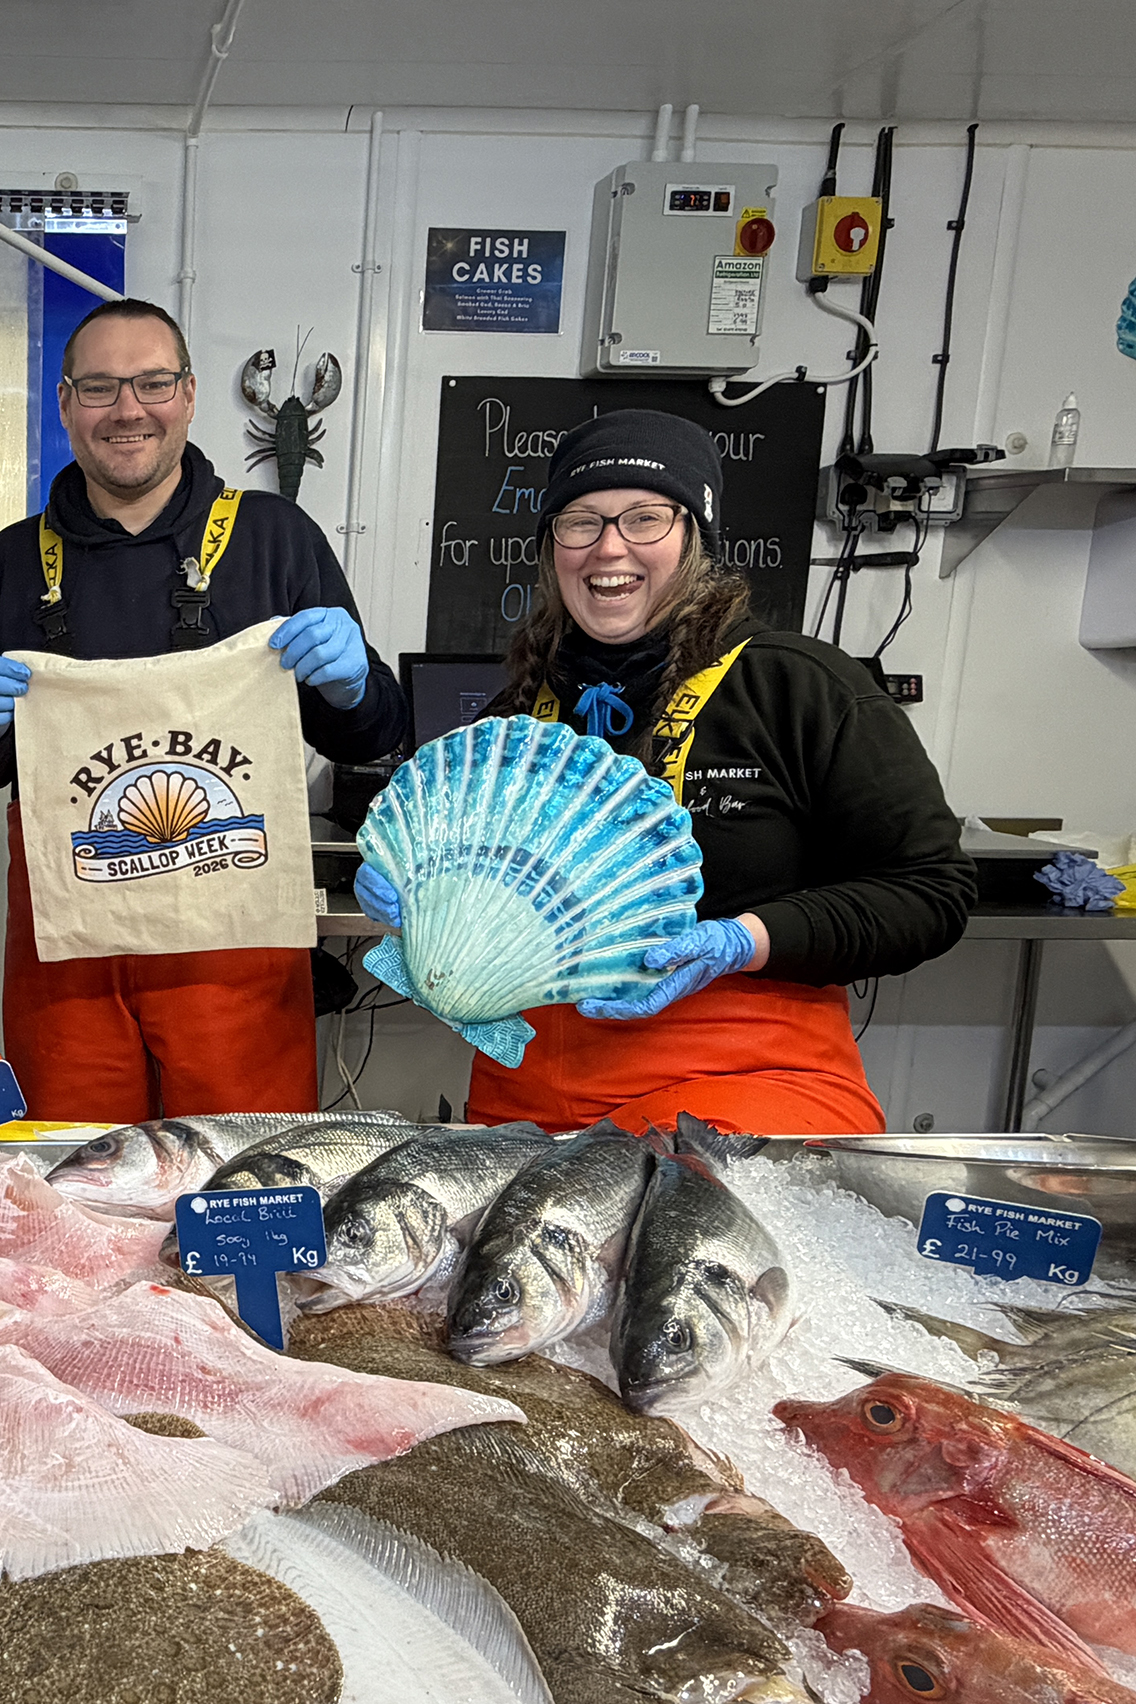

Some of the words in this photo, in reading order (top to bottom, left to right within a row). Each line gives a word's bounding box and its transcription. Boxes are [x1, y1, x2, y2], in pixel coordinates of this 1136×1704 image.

[469, 237, 529, 258] FISH
[452, 262, 542, 284] CAKES
[716, 260, 761, 270] Amazon
[709, 431, 765, 461] our
[589, 458, 615, 469] FISH
[618, 458, 666, 470] MARKET
[440, 521, 479, 567] for
[685, 770, 703, 781] SH
[707, 768, 762, 779] MARKET
[107, 850, 180, 877] SCALLOP
[185, 835, 230, 859] WEEK
[193, 859, 230, 877] 2026
[11, 1109, 24, 1118] Kg
[209, 1199, 230, 1209] RYE
[233, 1196, 257, 1207] FISH
[260, 1194, 303, 1206] MARKET
[967, 1203, 993, 1215] RYE
[995, 1209, 1025, 1221] FISH
[1027, 1214, 1082, 1231] MARKET
[946, 1214, 985, 1235] Fish
[994, 1221, 1020, 1240] Pie
[1036, 1230, 1071, 1246] Mix
[186, 1252, 202, 1274] £
[293, 1247, 318, 1267] Kg
[921, 1238, 942, 1258] £
[1048, 1263, 1079, 1285] Kg
